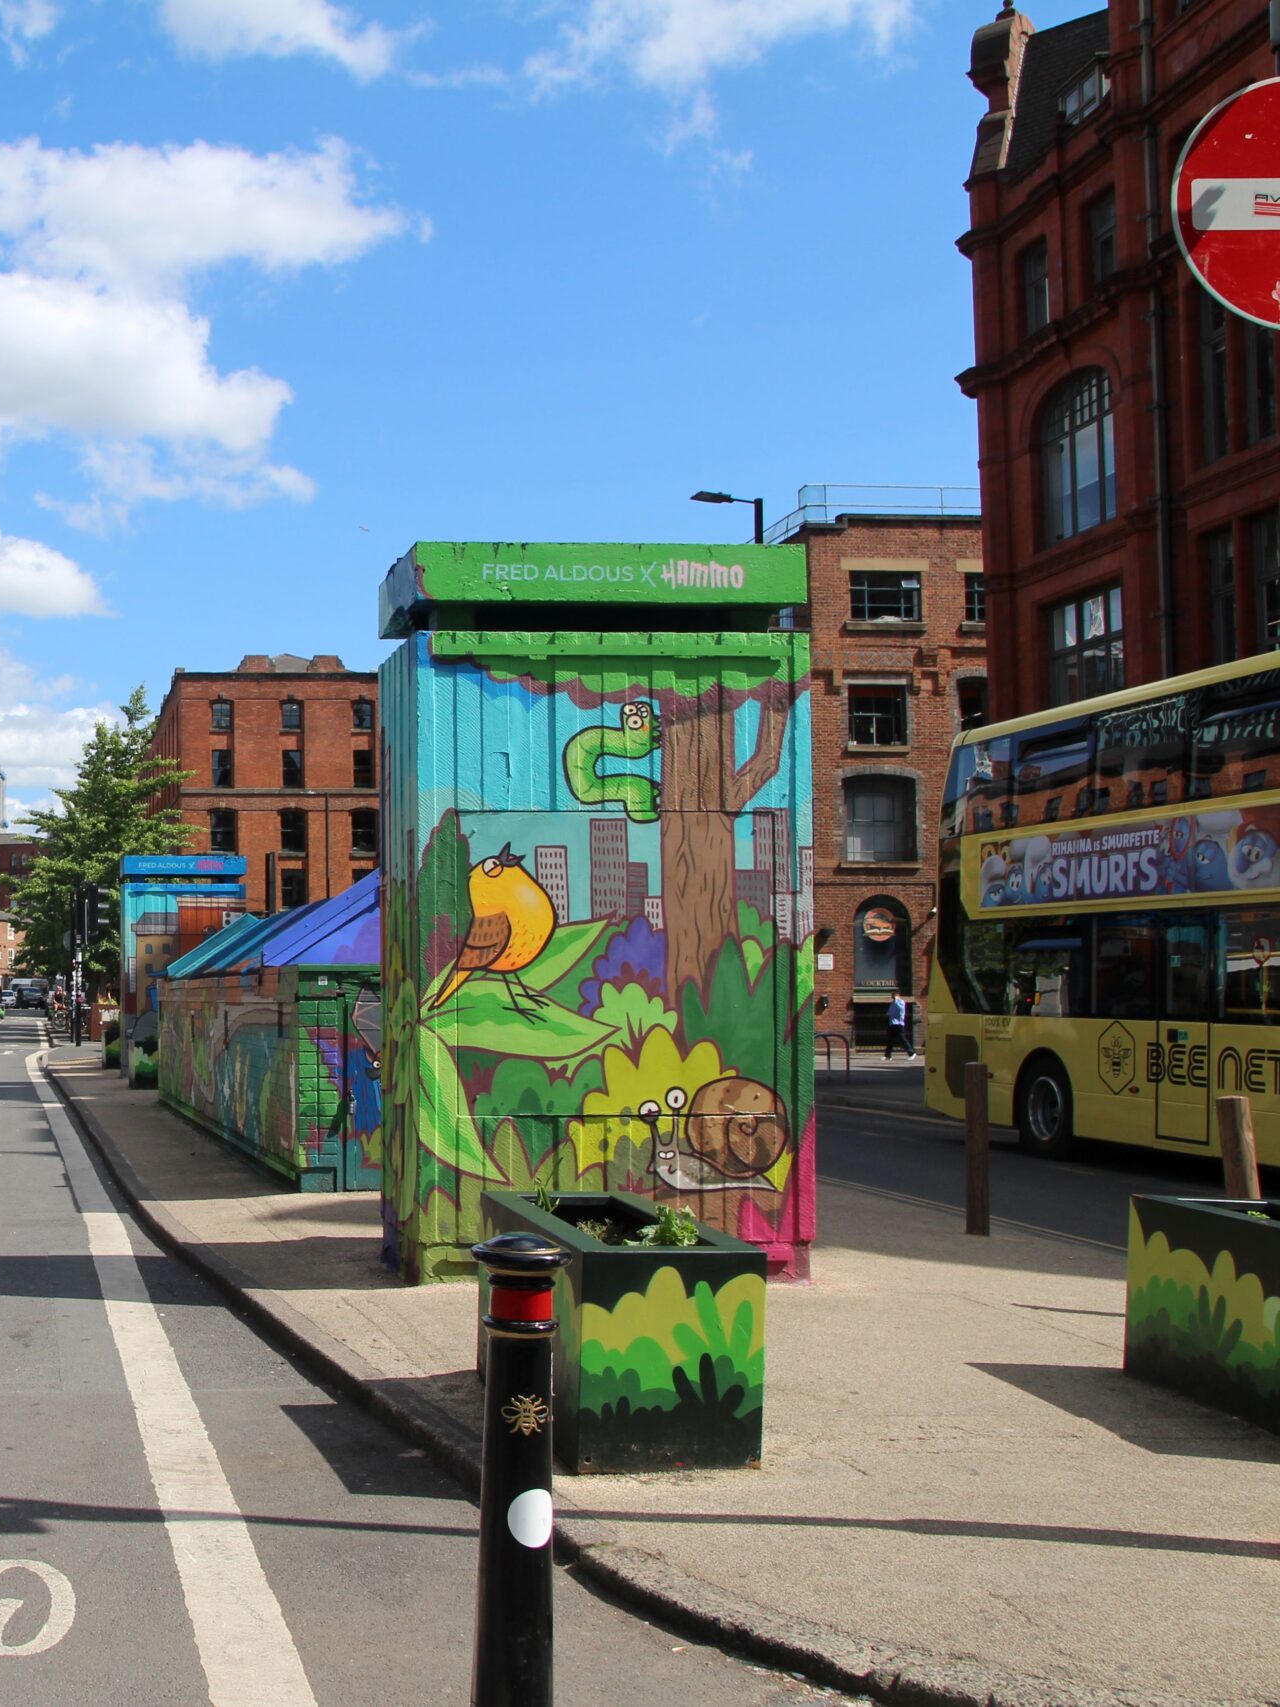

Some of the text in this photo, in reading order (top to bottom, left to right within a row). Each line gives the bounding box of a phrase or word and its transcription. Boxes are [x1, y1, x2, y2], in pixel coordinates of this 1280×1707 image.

[482, 563, 539, 582] FRED
[544, 563, 634, 582] ALDOUS
[640, 561, 657, 587] X
[1051, 838, 1092, 856] RIHANNA
[1101, 829, 1160, 850] SMURFETTE
[1052, 848, 1158, 898] SMURFS
[1147, 1042, 1208, 1087] BEE
